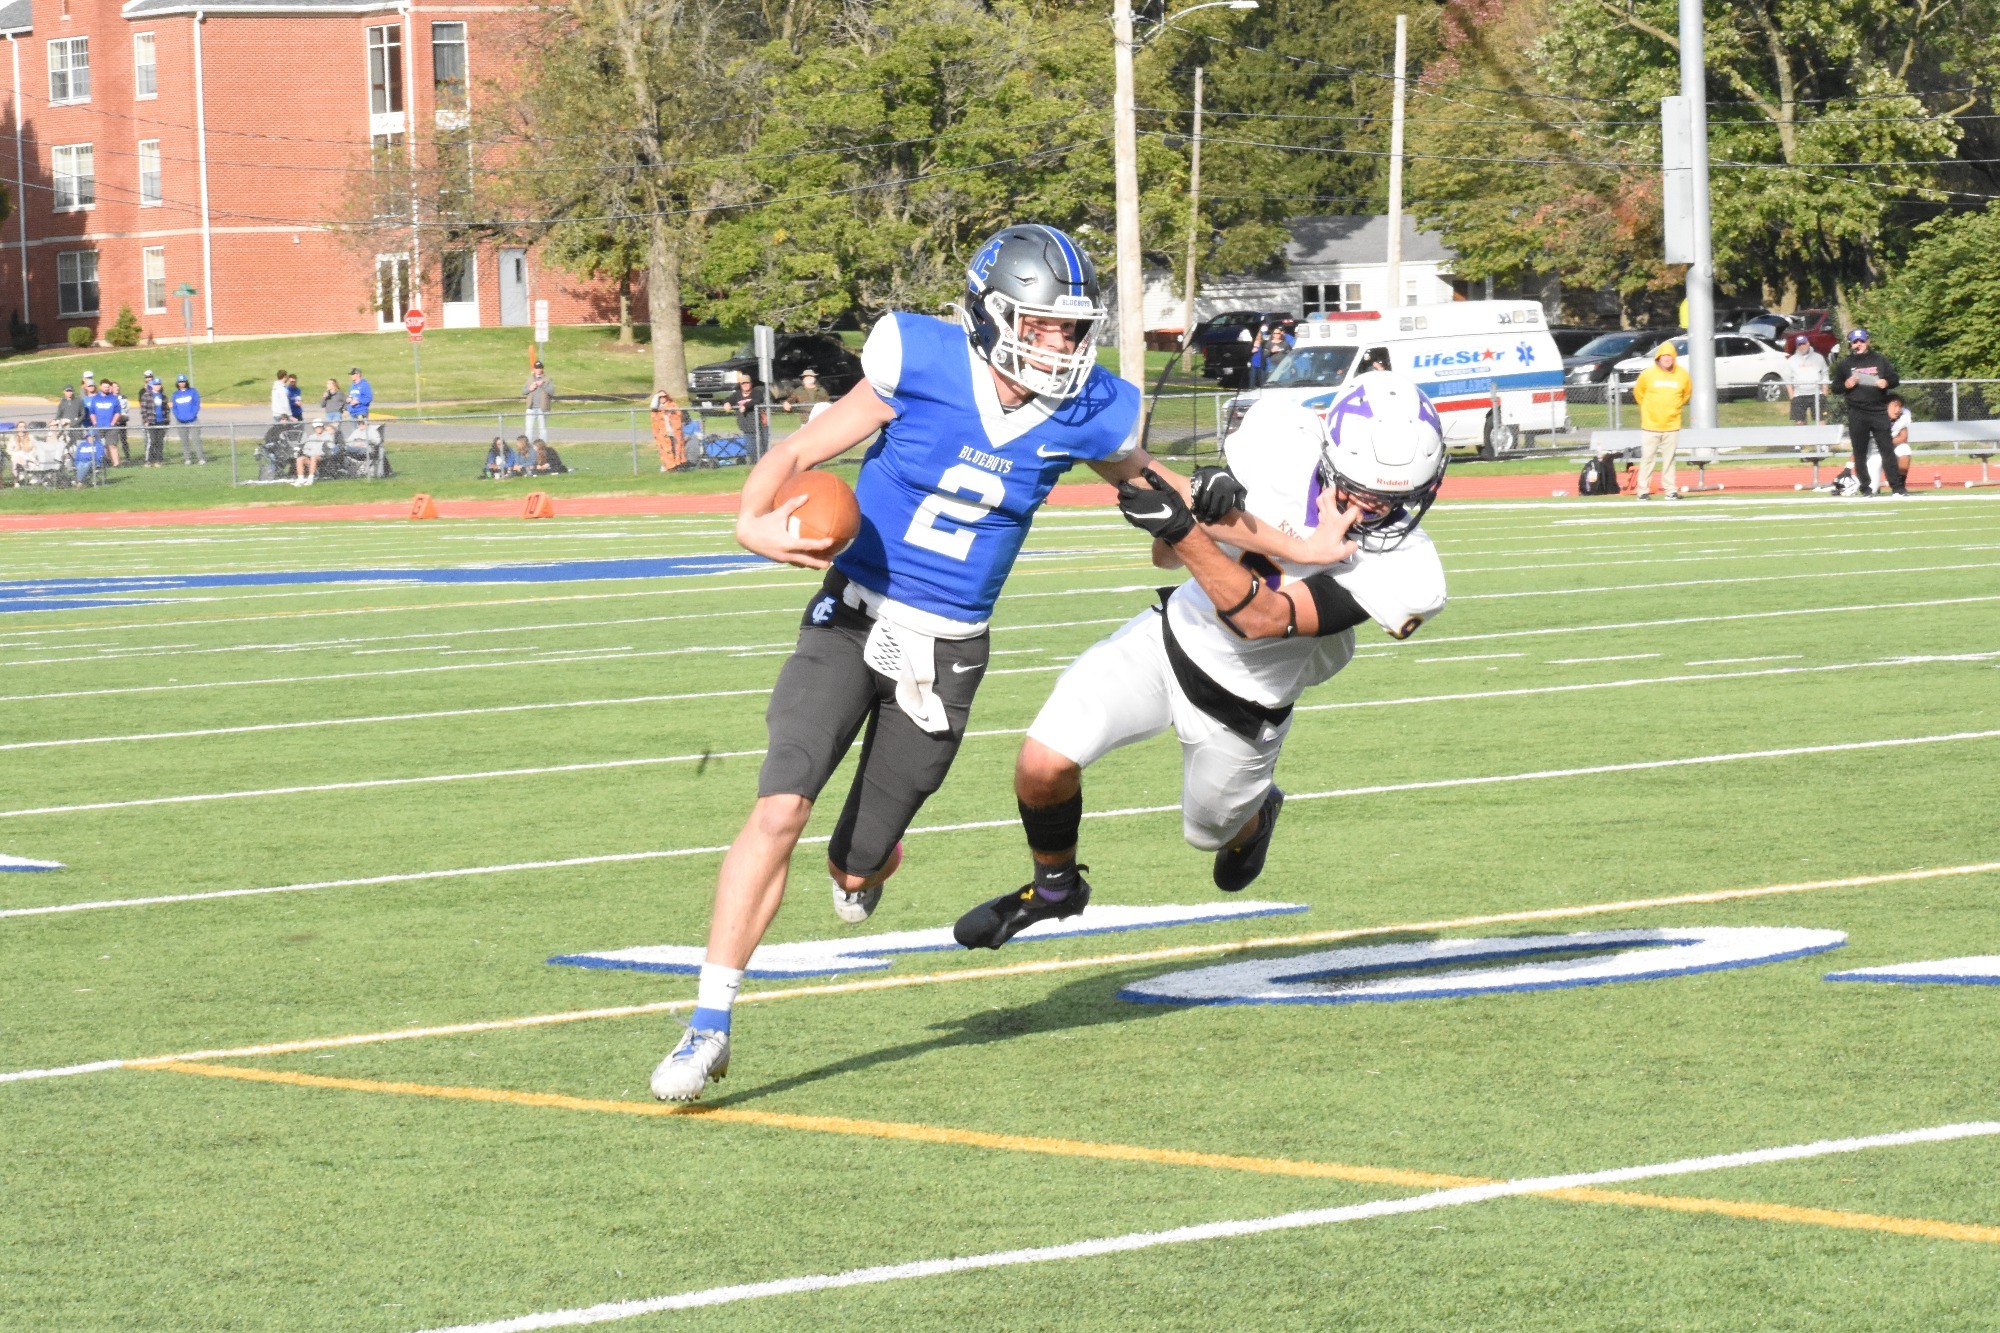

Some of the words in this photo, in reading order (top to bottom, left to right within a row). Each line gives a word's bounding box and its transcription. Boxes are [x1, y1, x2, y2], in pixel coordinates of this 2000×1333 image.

[1061, 300, 1091, 308] BLUEBOYS
[405, 316, 425, 327] STOP
[1438, 378, 1492, 396] AMBULANCE
[958, 445, 1014, 474] BLUEBOYS
[1376, 477, 1409, 486] Riddell
[903, 463, 1006, 561] 2
